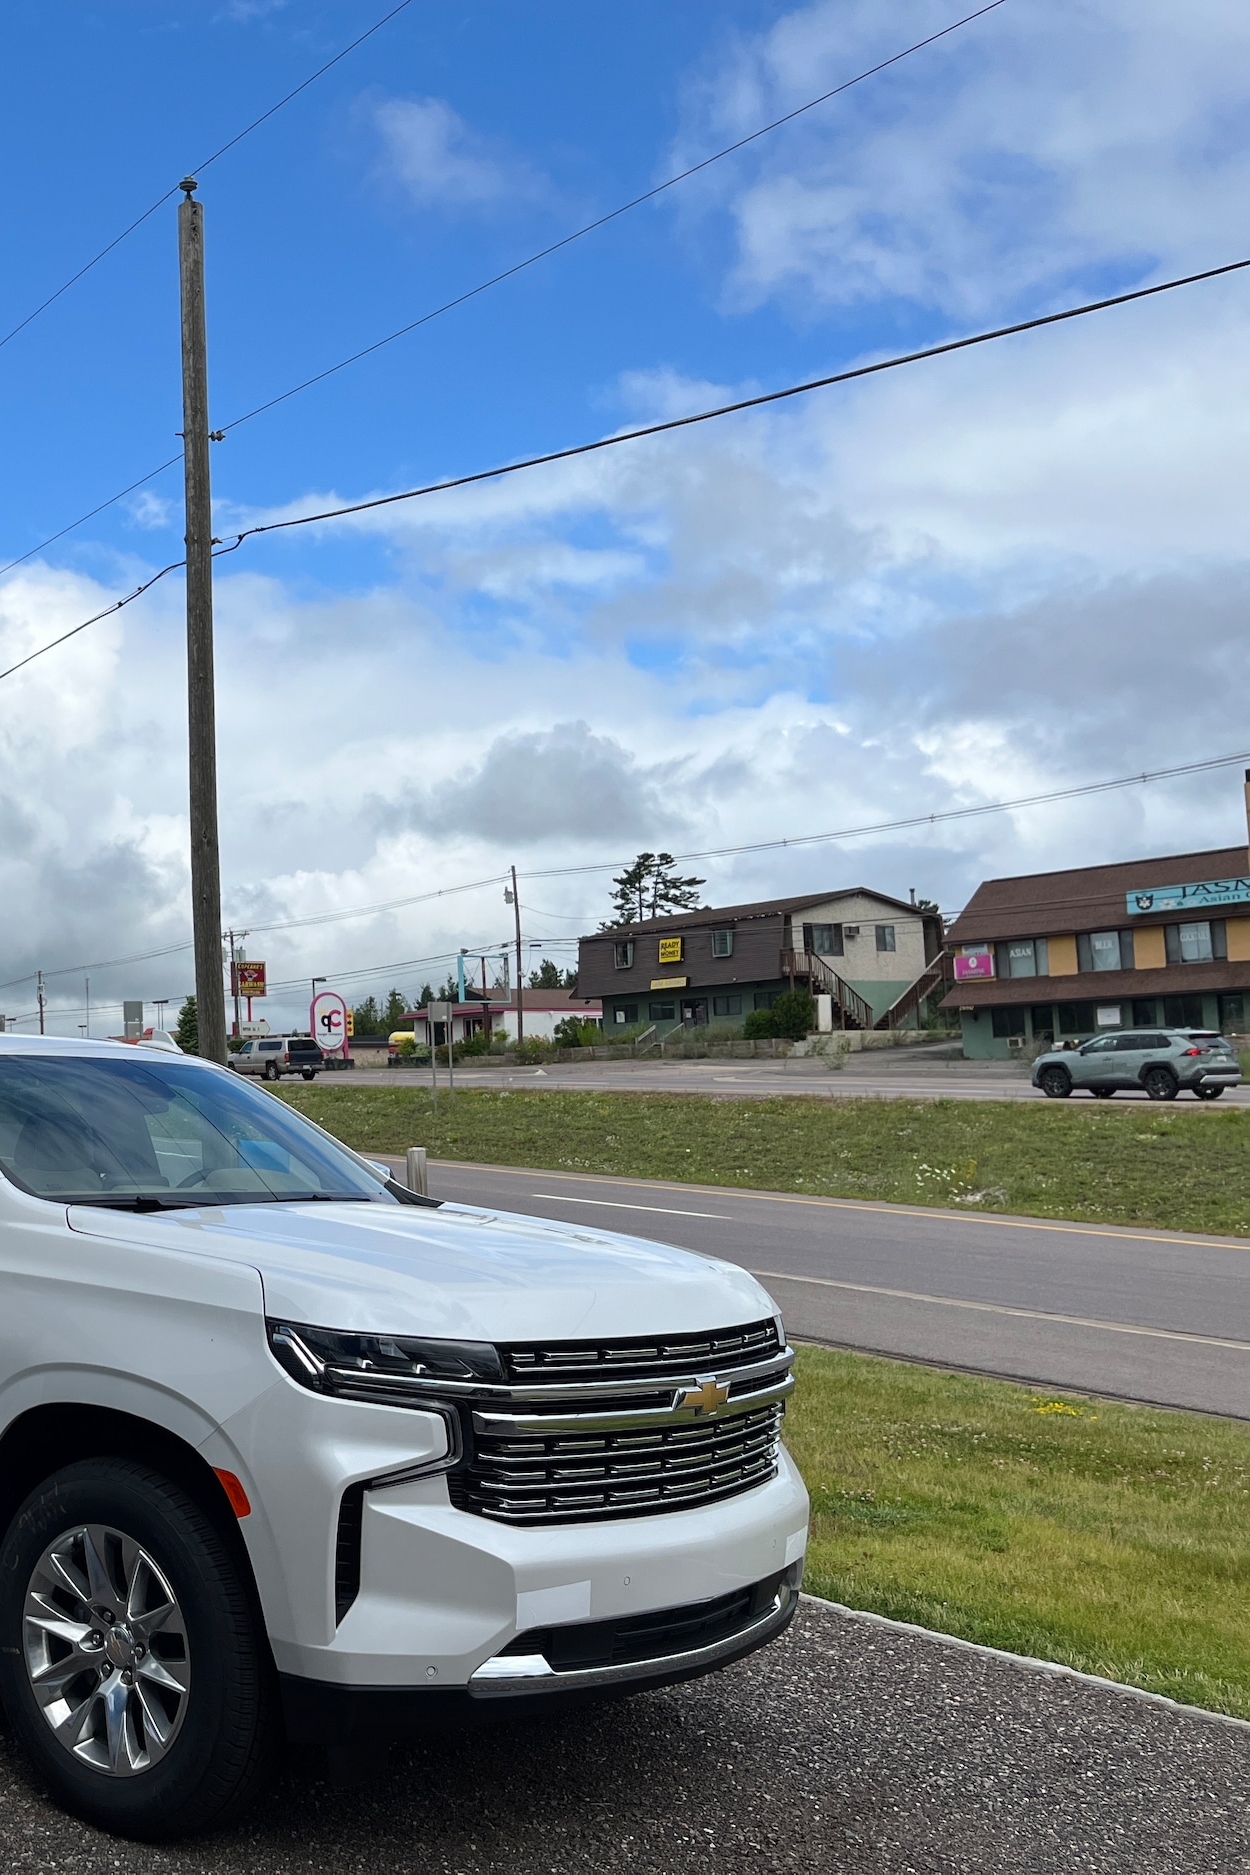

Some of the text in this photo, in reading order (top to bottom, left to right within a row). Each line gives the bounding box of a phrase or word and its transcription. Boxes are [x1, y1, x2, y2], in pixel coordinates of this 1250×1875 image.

[1199, 893, 1240, 904] Asian
[661, 941, 680, 950] READY
[1095, 940, 1113, 950] BEER
[1009, 947, 1032, 958] ASIAN
